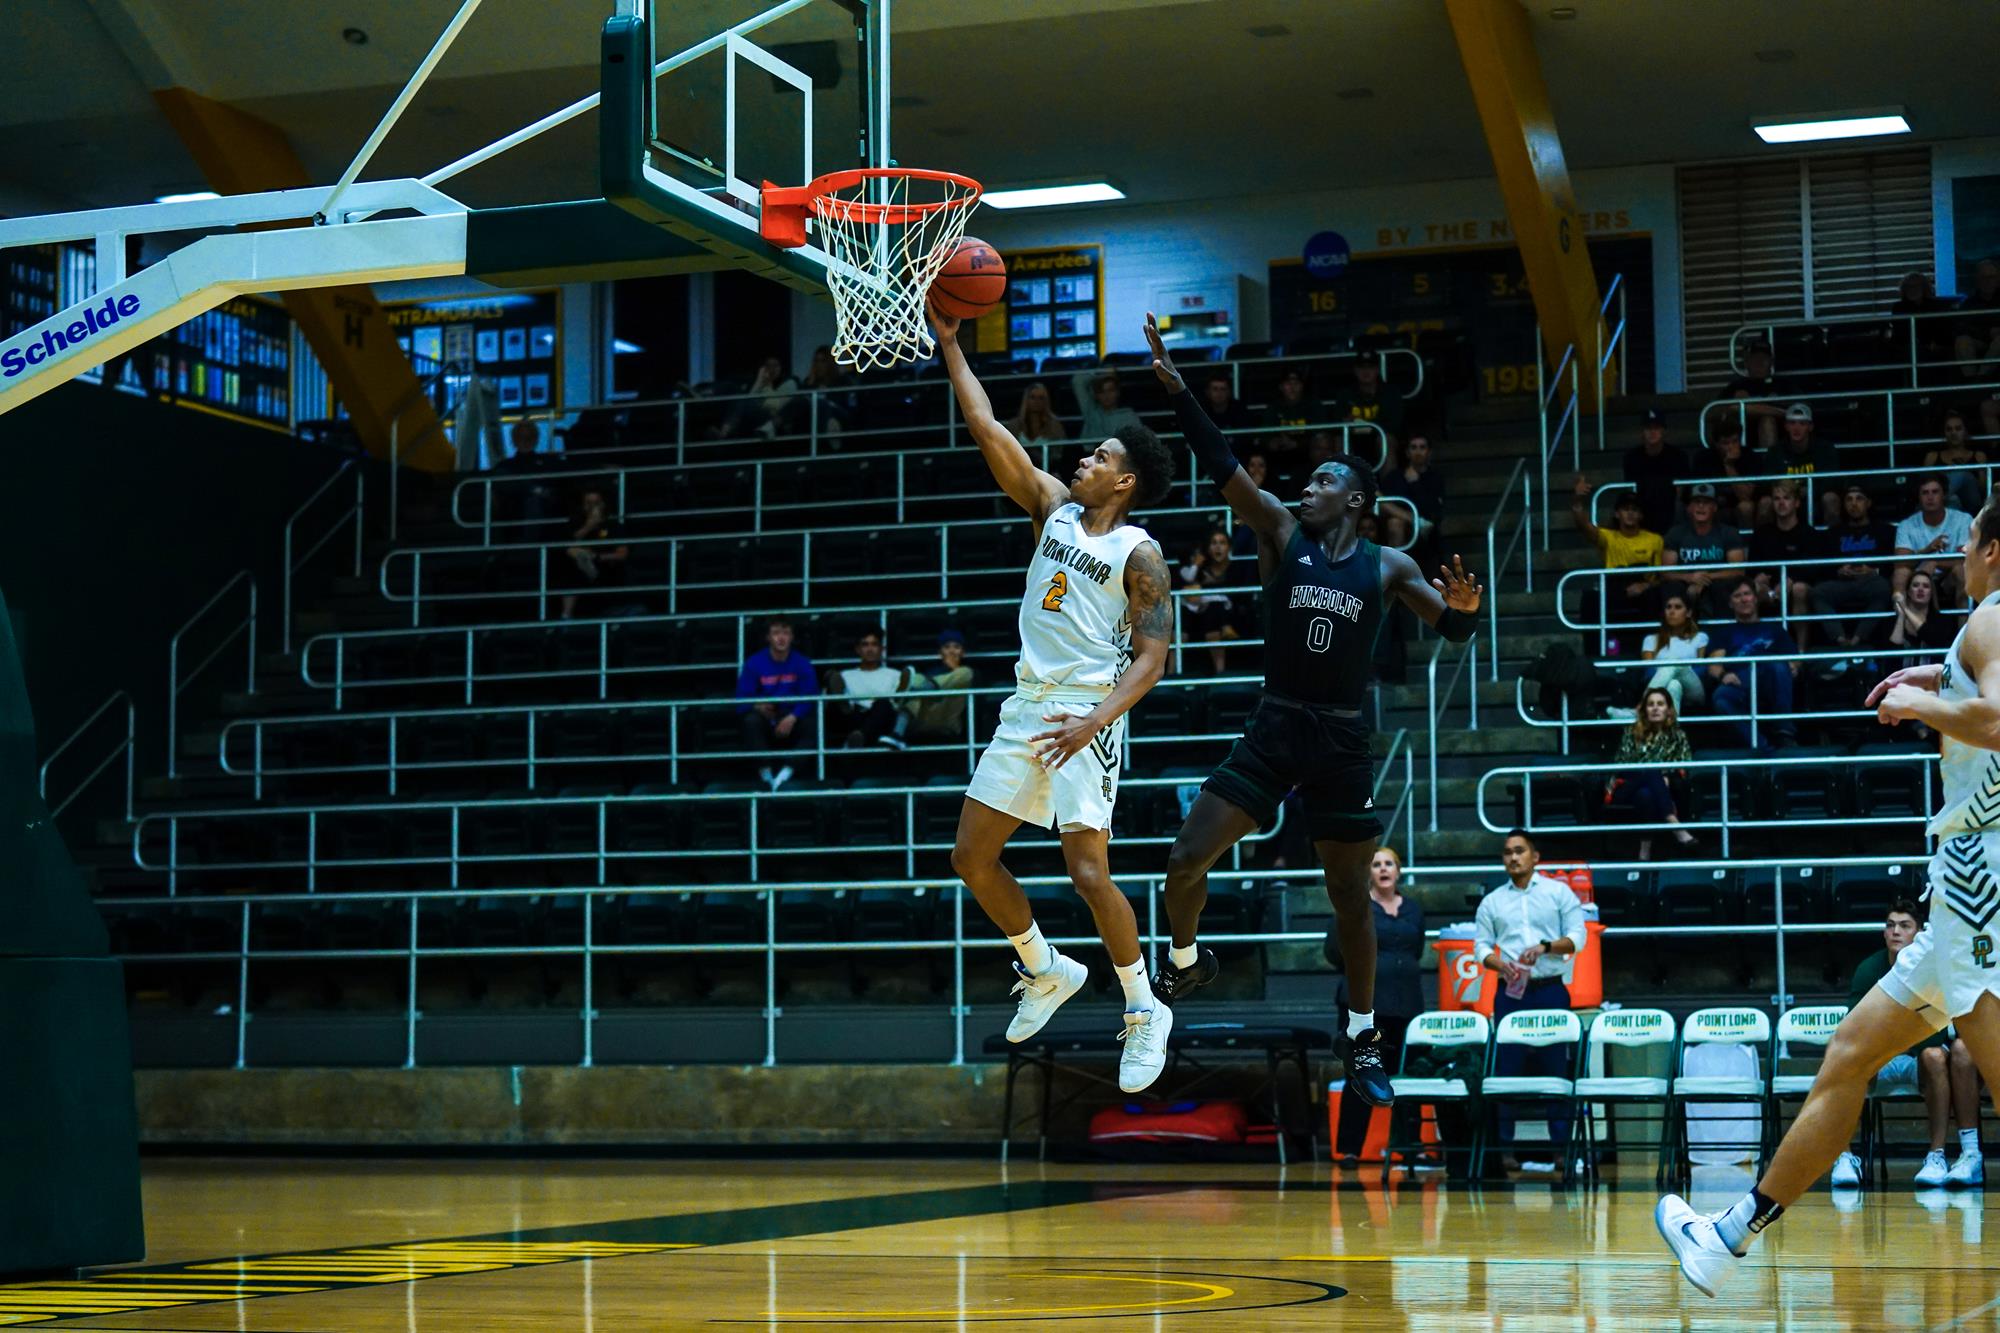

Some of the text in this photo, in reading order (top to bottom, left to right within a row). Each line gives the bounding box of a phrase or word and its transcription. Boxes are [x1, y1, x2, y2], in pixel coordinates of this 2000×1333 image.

[1377, 227, 1410, 247] BY
[1425, 221, 1478, 242] THE
[1308, 290, 1337, 313] 16
[387, 307, 504, 327] NTRAMURALS
[0, 294, 140, 377] Schelde
[1067, 548, 1112, 586] LOMA
[1041, 570, 1068, 613] 2
[1289, 585, 1364, 622] HUMBOLDT
[1307, 616, 1333, 653] 0
[1456, 954, 1479, 979] G
[1420, 1017, 1476, 1030] POINT LOMA
[1511, 1015, 1568, 1028] POINT LOMA
[1604, 1014, 1662, 1028] POINT LOMA
[1697, 1013, 1756, 1026] POINT LOMA
[1791, 1012, 1845, 1026] POINT LOM
